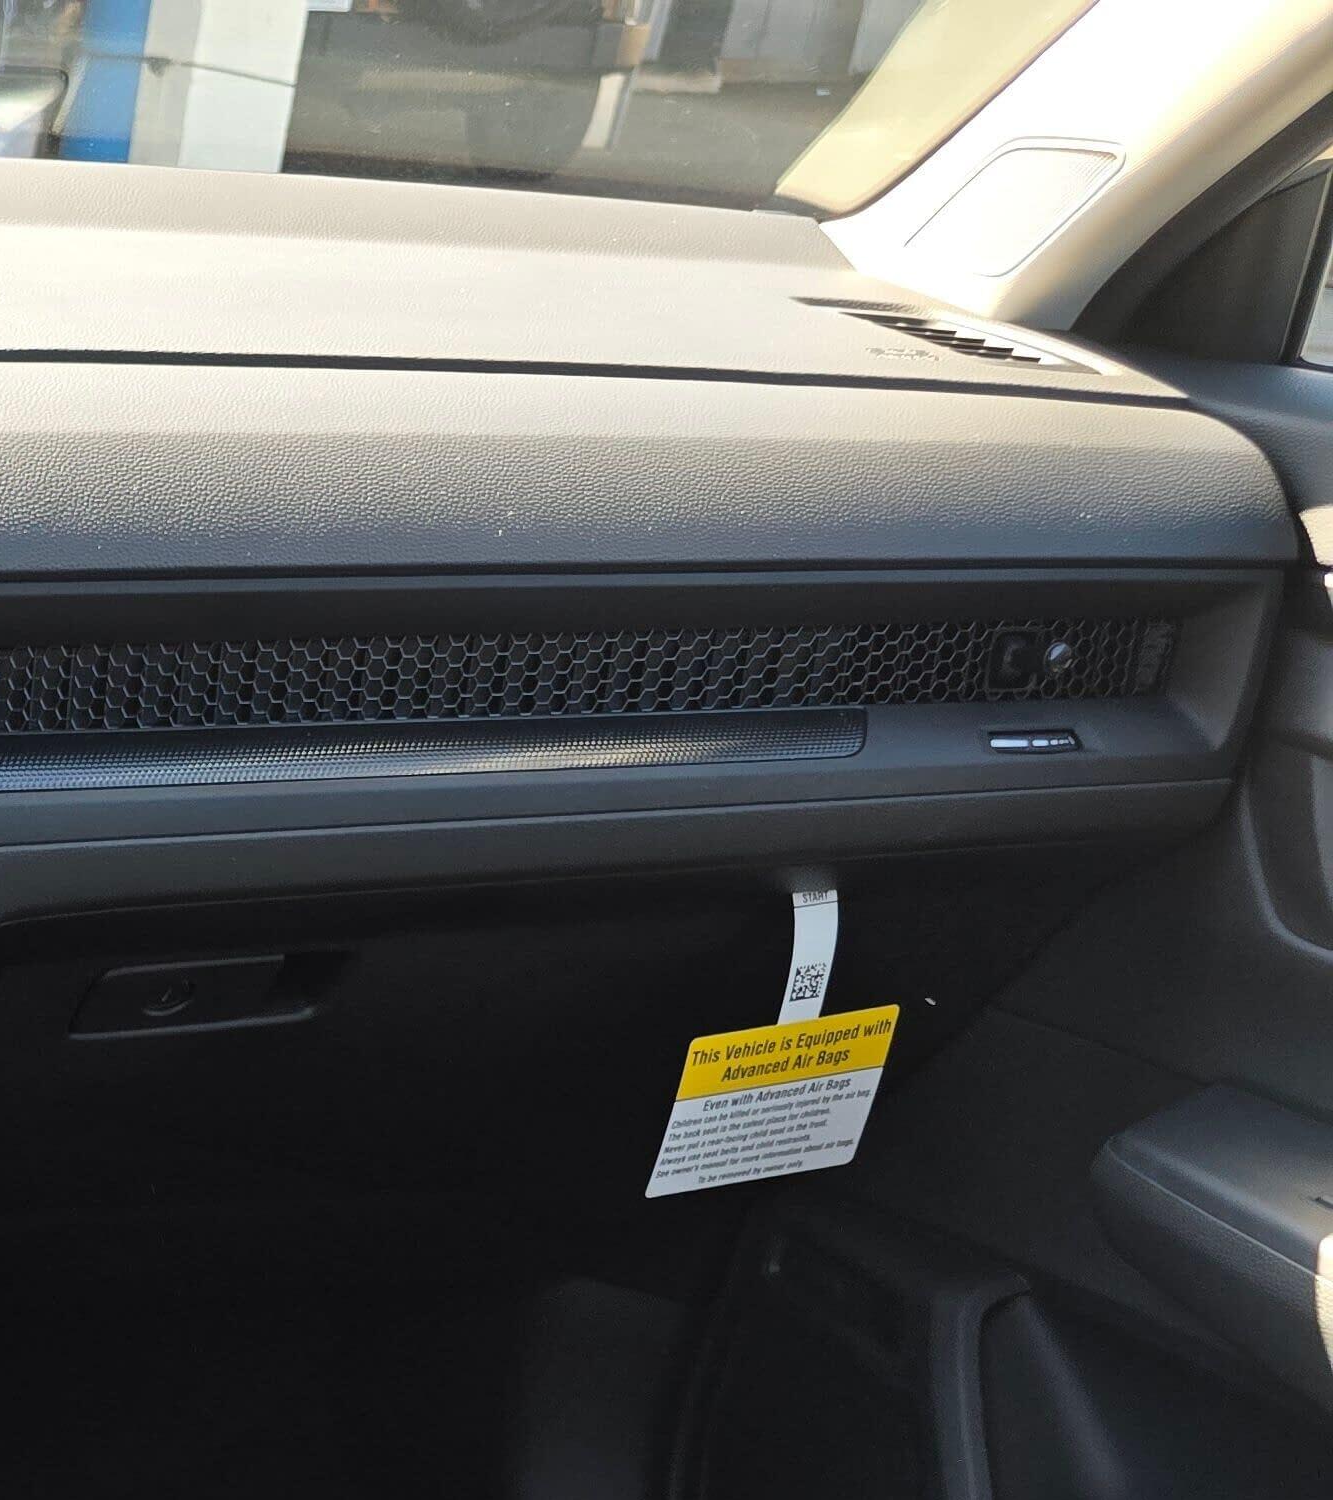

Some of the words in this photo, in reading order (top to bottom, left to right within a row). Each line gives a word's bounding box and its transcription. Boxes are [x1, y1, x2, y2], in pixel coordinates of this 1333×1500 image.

[692, 1049, 721, 1066] This
[725, 1039, 777, 1060] Vehicle
[779, 1036, 792, 1052] is
[795, 1024, 861, 1050] Equipped
[863, 1018, 892, 1036] with
[720, 1056, 790, 1083] Advanced
[792, 1053, 814, 1071] Air
[816, 1048, 851, 1066] Bags
[671, 1118, 703, 1130] Children
[822, 1096, 831, 1104] by
[832, 1093, 844, 1102] the
[703, 1099, 729, 1112] Even
[732, 1092, 754, 1106] with
[755, 1084, 807, 1102] Advanced
[808, 1081, 823, 1094] Air
[825, 1078, 851, 1092] Bags
[663, 1144, 686, 1154] Never
[749, 1129, 768, 1140] child
[795, 1122, 807, 1132] the
[669, 1133, 682, 1142] The
[683, 1129, 701, 1139] back
[729, 1122, 741, 1131] the
[655, 1170, 670, 1179] See
[659, 1155, 686, 1166] Always
